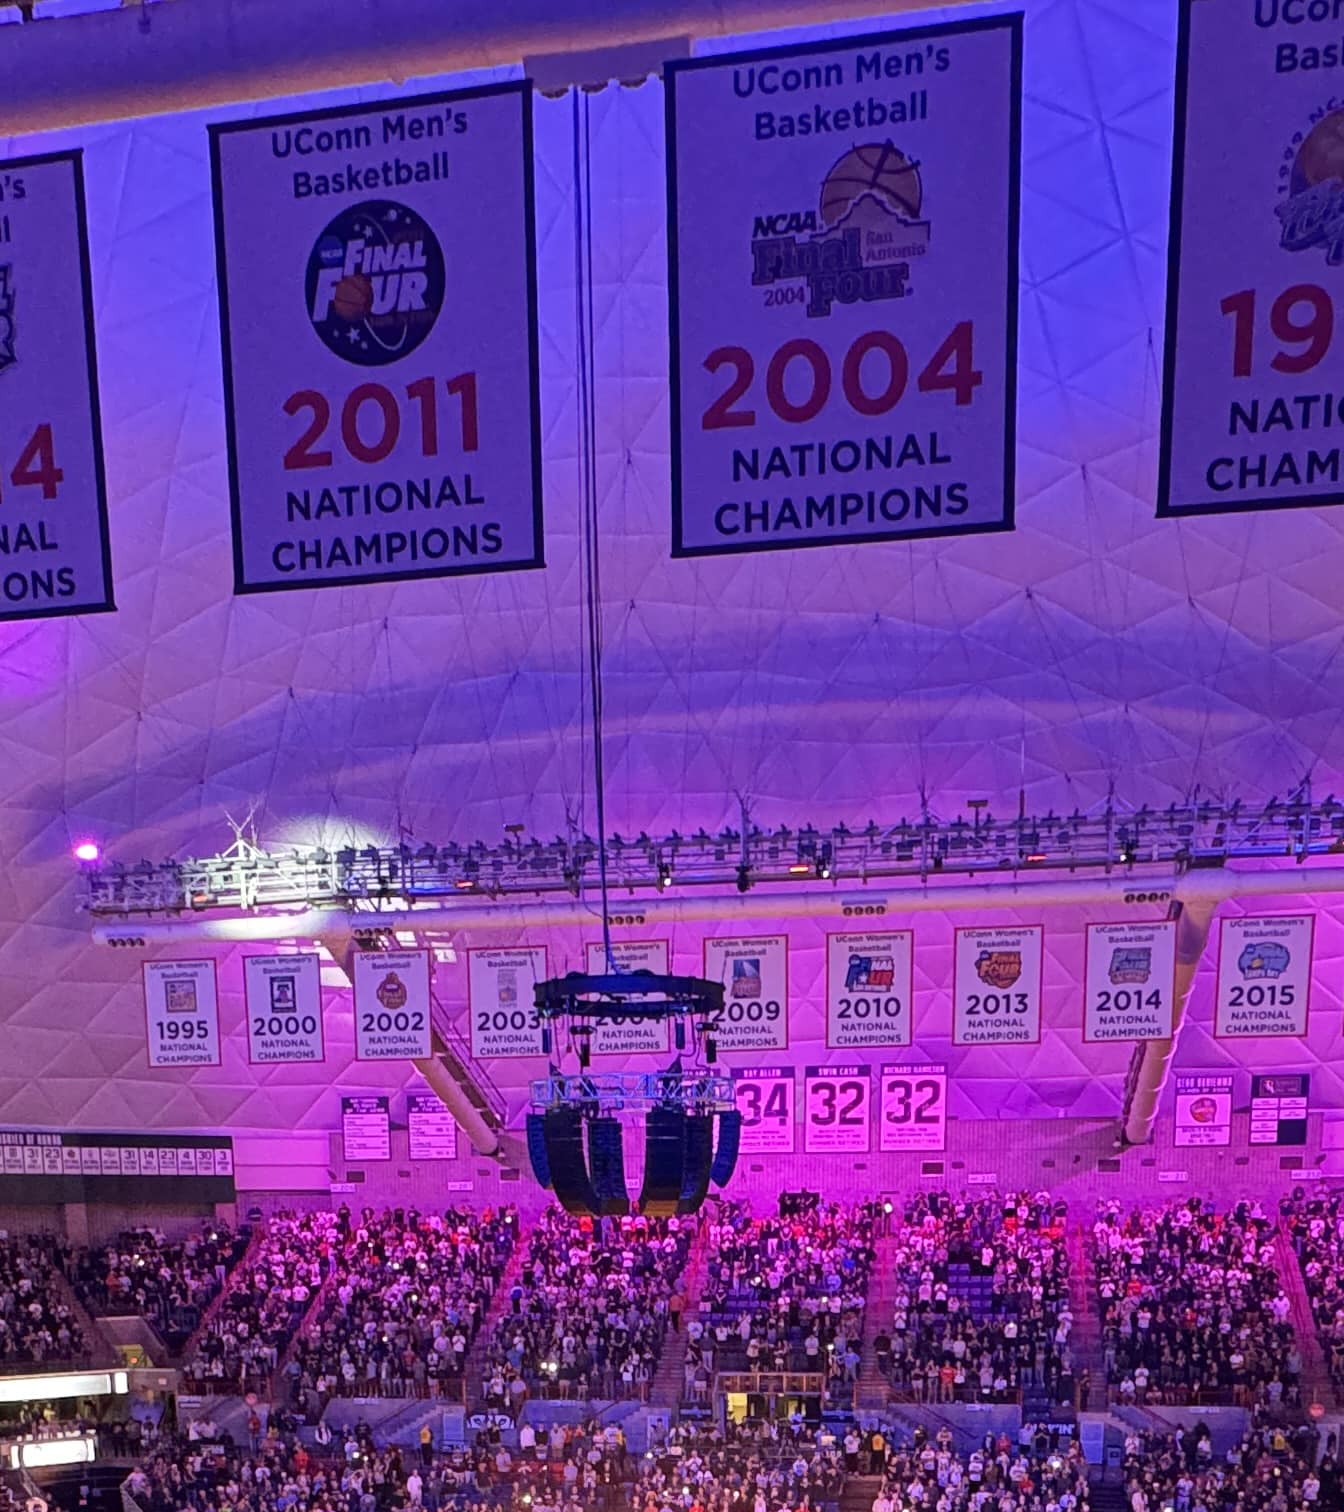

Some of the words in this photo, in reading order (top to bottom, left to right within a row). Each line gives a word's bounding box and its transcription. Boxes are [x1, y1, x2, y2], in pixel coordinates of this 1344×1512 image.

[732, 63, 843, 99] UConn
[854, 44, 951, 81] Men's
[755, 90, 929, 141] Basketball
[271, 125, 371, 159] UConn
[382, 109, 468, 141] Men's
[292, 152, 450, 200] Basketball
[753, 211, 817, 238] NCAA
[344, 239, 427, 276] FINAL
[752, 228, 863, 286] Final
[866, 243, 926, 262] Antonio
[764, 286, 805, 307] 2004
[702, 321, 983, 431] 2004
[282, 372, 480, 471] 2011
[732, 432, 951, 483] NATIONAL
[286, 475, 485, 522] NATIONAL
[714, 482, 969, 537] CHAMPIONS
[271, 522, 504, 574] CHAMPIONS
[966, 994, 1028, 1015] 2013
[1096, 989, 1162, 1011] 2014
[1229, 985, 1294, 1007] 2015
[713, 1001, 780, 1022] 2009
[838, 997, 901, 1018] 2010
[1231, 1010, 1291, 1021] NATIONAL
[254, 1016, 316, 1036] 2000
[362, 1012, 425, 1032] 2002
[477, 1011, 541, 1031] 2003
[842, 1022, 896, 1031] NATIONAL
[968, 1019, 1024, 1028] NATIONAL
[1099, 1014, 1158, 1025] NATIONAL
[1226, 1024, 1296, 1033] CHAMPIONS
[157, 1020, 209, 1040] 1995
[369, 1035, 419, 1044] NATIONAL
[483, 1034, 535, 1043] NATIONAL
[603, 1029, 655, 1038] NATIONAL
[719, 1026, 773, 1035] NATIONAL
[836, 1035, 901, 1044] CHAMPIONS
[963, 1031, 1030, 1041] CHAMPIONS
[1094, 1027, 1163, 1038] CHAMPIONS
[160, 1043, 208, 1052] NATIONAL
[261, 1040, 311, 1048] NATIONAL
[365, 1047, 423, 1056] CHAMPIONS
[480, 1046, 540, 1055] CHAMPIONS
[599, 1041, 660, 1051] CHAMPIONS
[157, 1054, 212, 1063] CHAMPIONS
[258, 1051, 315, 1060] CHAMPIONS
[736, 1083, 788, 1126] 34
[811, 1081, 864, 1125] 32
[886, 1080, 940, 1124] 32
